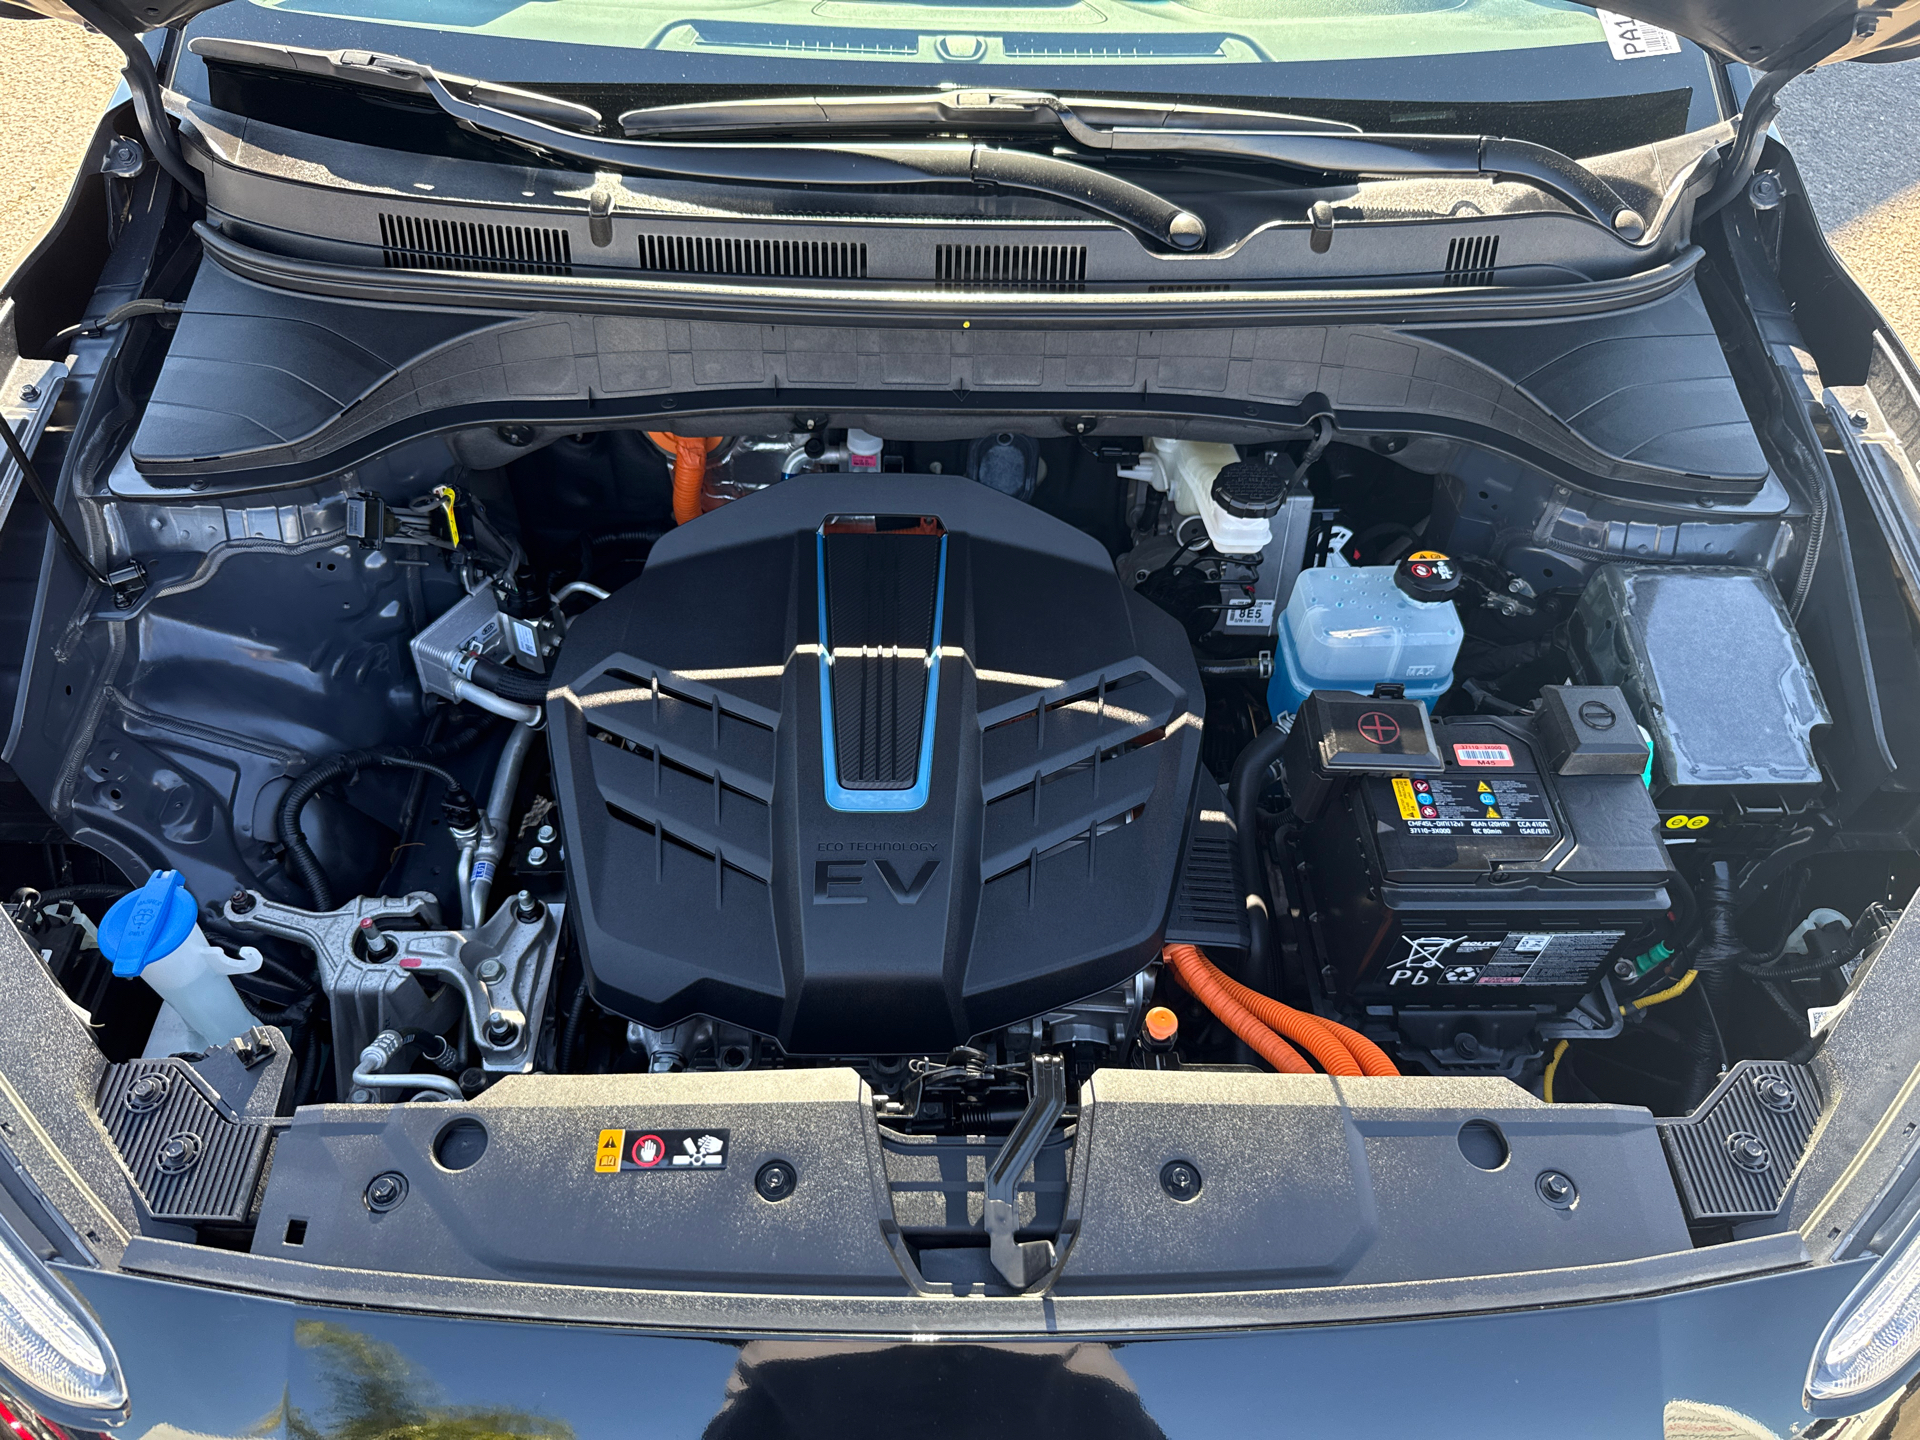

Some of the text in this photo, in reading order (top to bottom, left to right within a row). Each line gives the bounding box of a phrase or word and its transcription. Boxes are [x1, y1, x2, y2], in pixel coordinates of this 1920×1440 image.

[1239, 609, 1262, 619] 8E5
[1406, 668, 1435, 677] MAX
[818, 842, 938, 851] ECO TECHNOLOGY
[813, 859, 942, 905] EV
[1389, 970, 1429, 986] Pb
